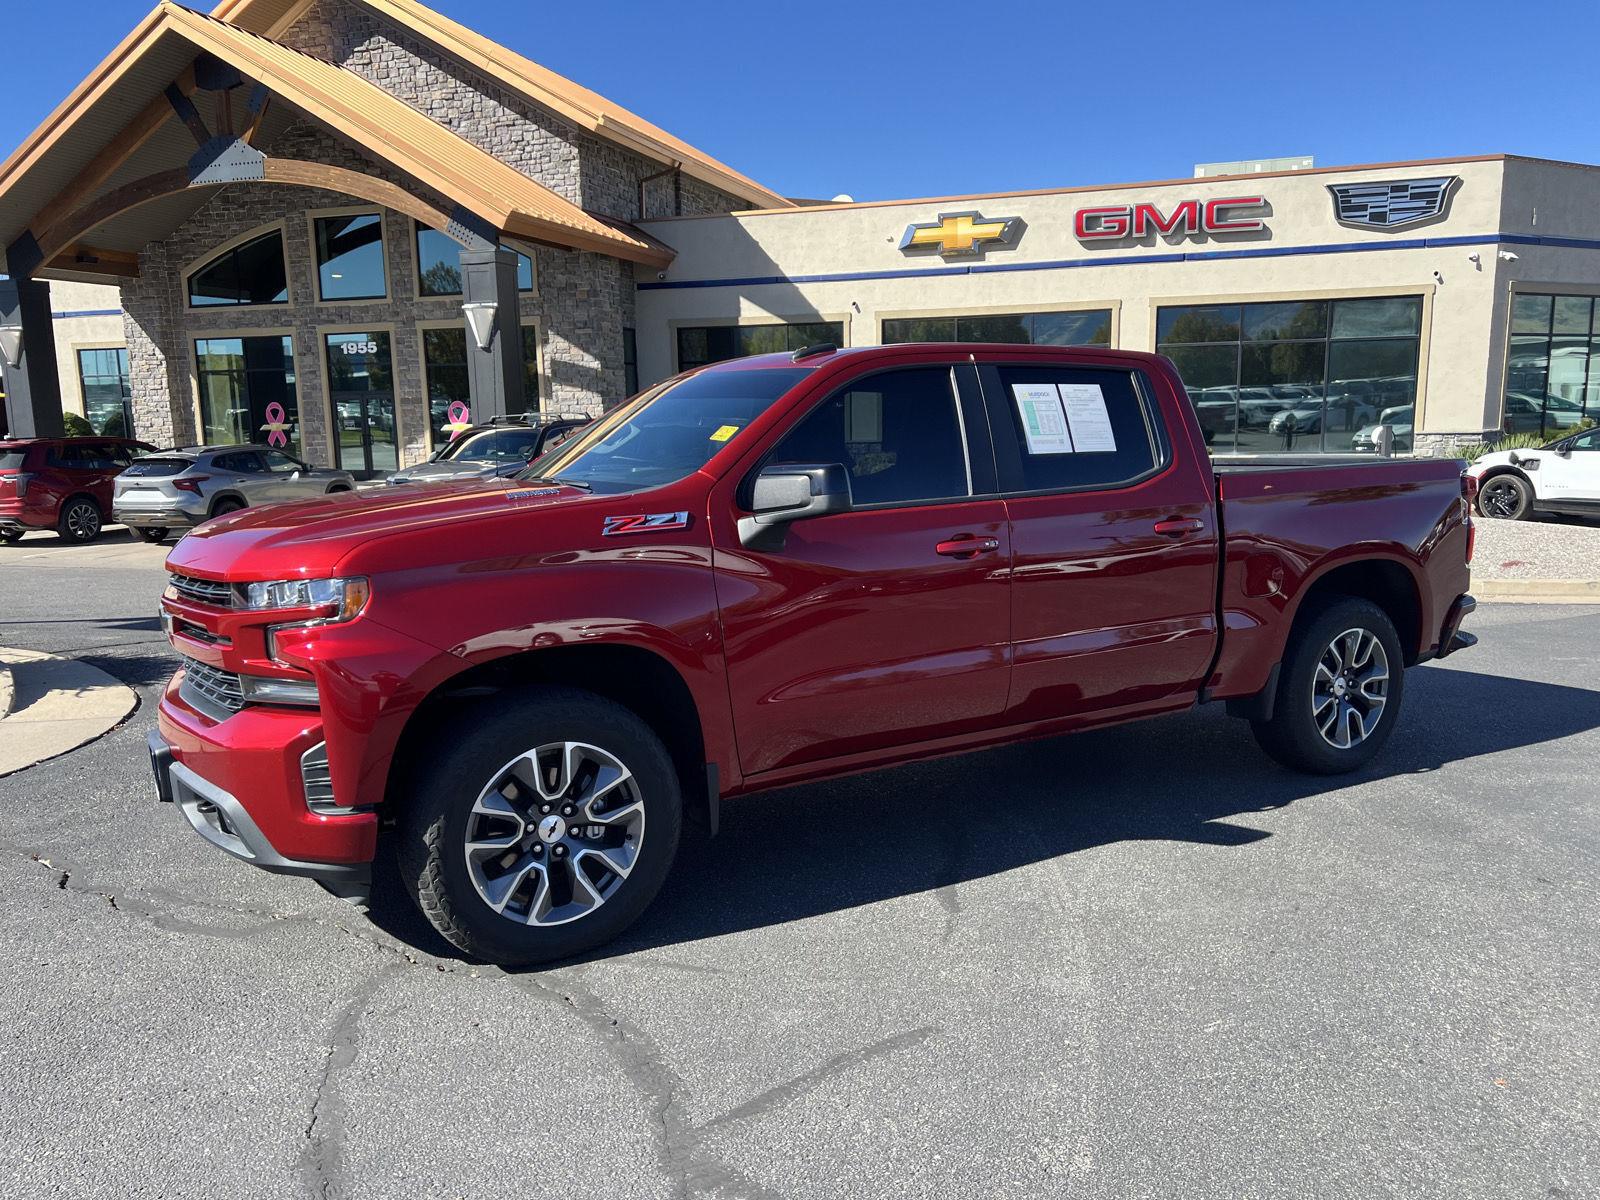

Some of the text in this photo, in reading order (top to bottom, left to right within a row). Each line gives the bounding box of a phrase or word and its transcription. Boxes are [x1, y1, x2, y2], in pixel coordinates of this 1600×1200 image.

[1073, 195, 1265, 241] GMC
[340, 341, 378, 355] 1955
[602, 511, 689, 536] Z71
